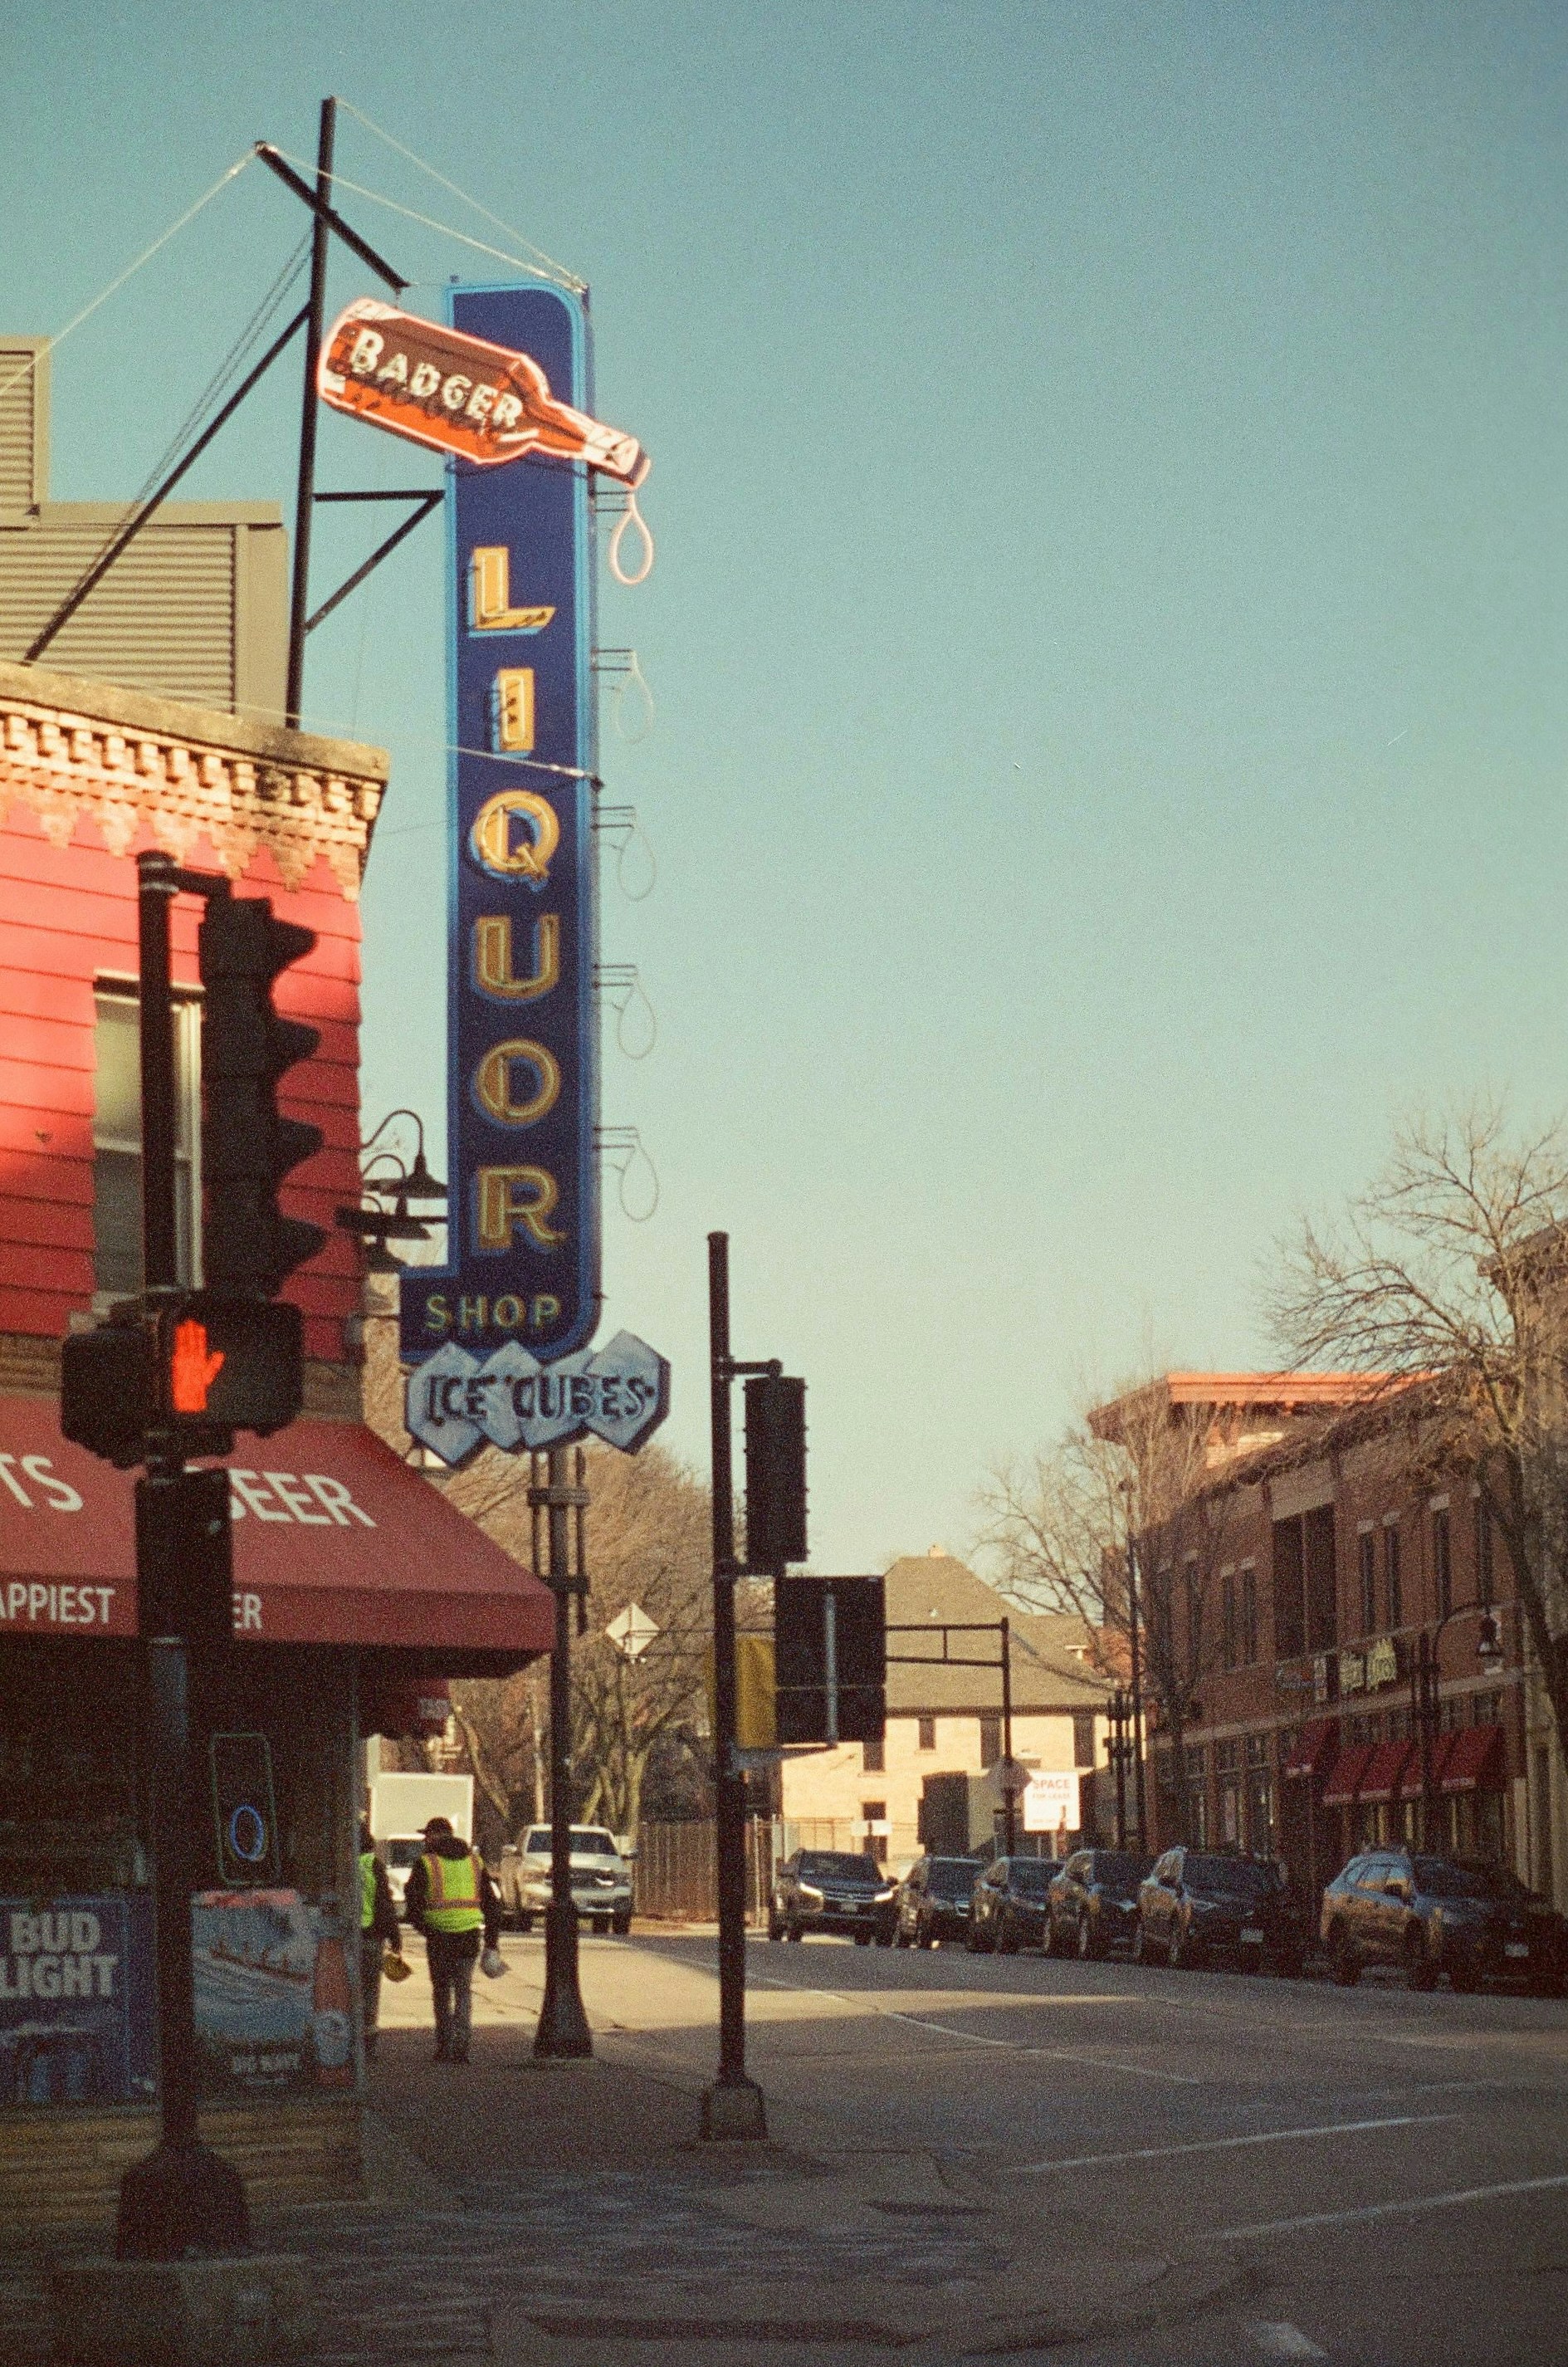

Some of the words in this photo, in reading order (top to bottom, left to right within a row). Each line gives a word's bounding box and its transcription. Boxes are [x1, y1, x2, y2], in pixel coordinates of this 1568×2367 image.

[349, 329, 524, 429] BADGER
[470, 545, 568, 1252] LIQUOR
[425, 1292, 562, 1330] SHOP
[428, 1374, 496, 1426] ICE
[512, 1374, 656, 1418] CUBES
[184, 1465, 377, 1528] EER
[1033, 1779, 1071, 1790] SPACE
[10, 1911, 100, 1953] BUD
[0, 1954, 119, 1998] LIGHT
